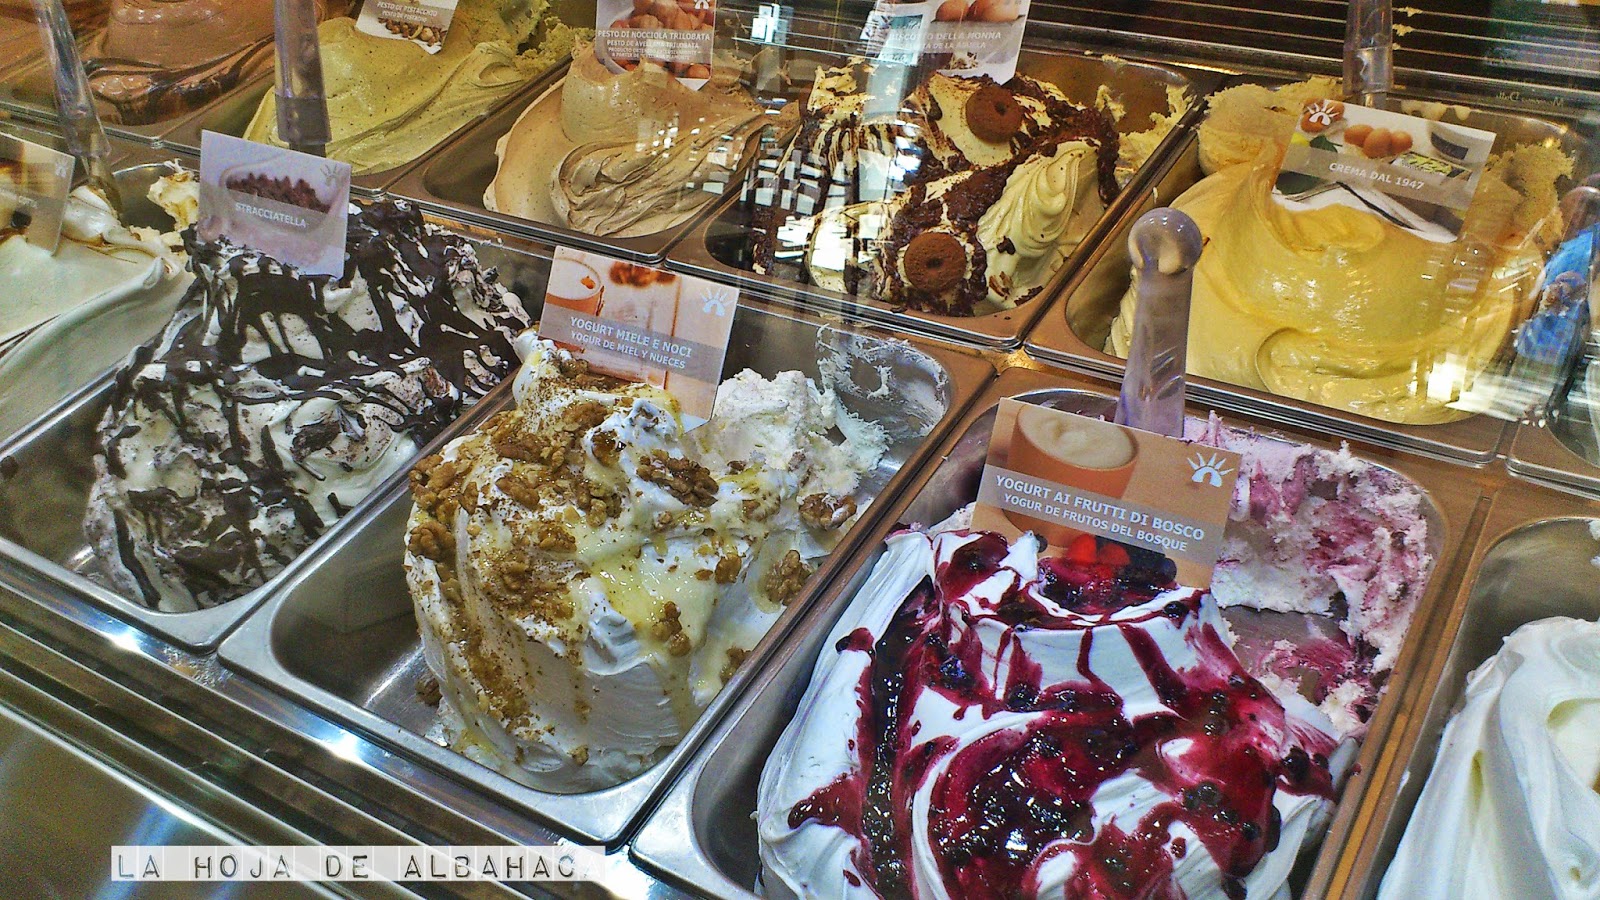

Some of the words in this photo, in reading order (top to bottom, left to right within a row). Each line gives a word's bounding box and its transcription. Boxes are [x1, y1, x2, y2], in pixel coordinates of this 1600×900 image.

[597, 30, 620, 38] PESTO
[620, 30, 630, 38] DI
[631, 31, 668, 40] NOCCIOLA
[669, 32, 711, 41] TRILOBATA
[935, 32, 965, 40] DELLA
[1328, 162, 1368, 181] CREMA
[1369, 170, 1392, 184] DAL
[1395, 176, 1425, 191] 1947
[235, 202, 307, 229] STRACCIATELLA
[570, 316, 614, 337] YOGURT
[616, 329, 650, 347] MIELE
[652, 339, 661, 350] E
[662, 342, 693, 359] NOCI
[570, 331, 601, 347] YOGUR
[602, 340, 615, 351] DE
[616, 343, 639, 357] MIEL
[641, 350, 648, 359] Y
[649, 352, 687, 370] NUECES
[995, 475, 1052, 500] YOGURT
[1053, 491, 1070, 506] AI
[1074, 497, 1127, 521] FRUTTI
[1129, 511, 1148, 527] DI
[1151, 517, 1205, 542] BOSCO
[1003, 493, 1042, 512] YOGUR
[1045, 503, 1060, 517] DE
[1062, 509, 1108, 530] FRUTOS
[1110, 522, 1134, 538] DEL
[1136, 529, 1188, 553] BOSQUE
